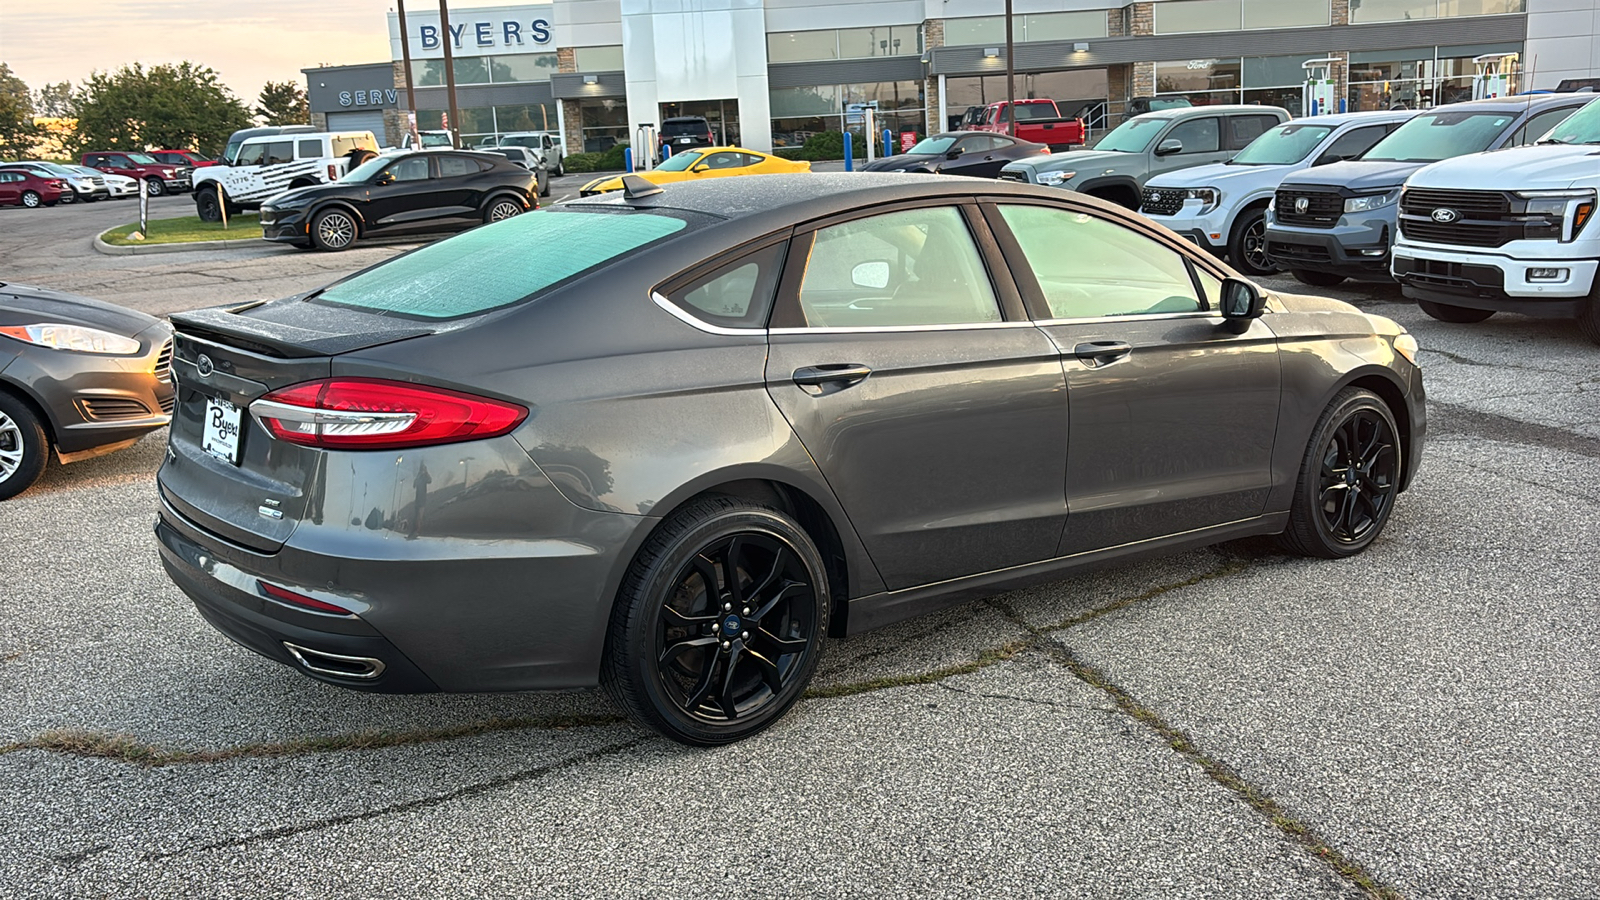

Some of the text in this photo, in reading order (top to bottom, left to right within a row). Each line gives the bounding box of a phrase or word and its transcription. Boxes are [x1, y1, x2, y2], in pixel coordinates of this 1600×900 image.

[420, 19, 551, 49] BYERS
[1187, 59, 1209, 69] Ford
[339, 89, 397, 107] SERV
[232, 176, 249, 184] 1776
